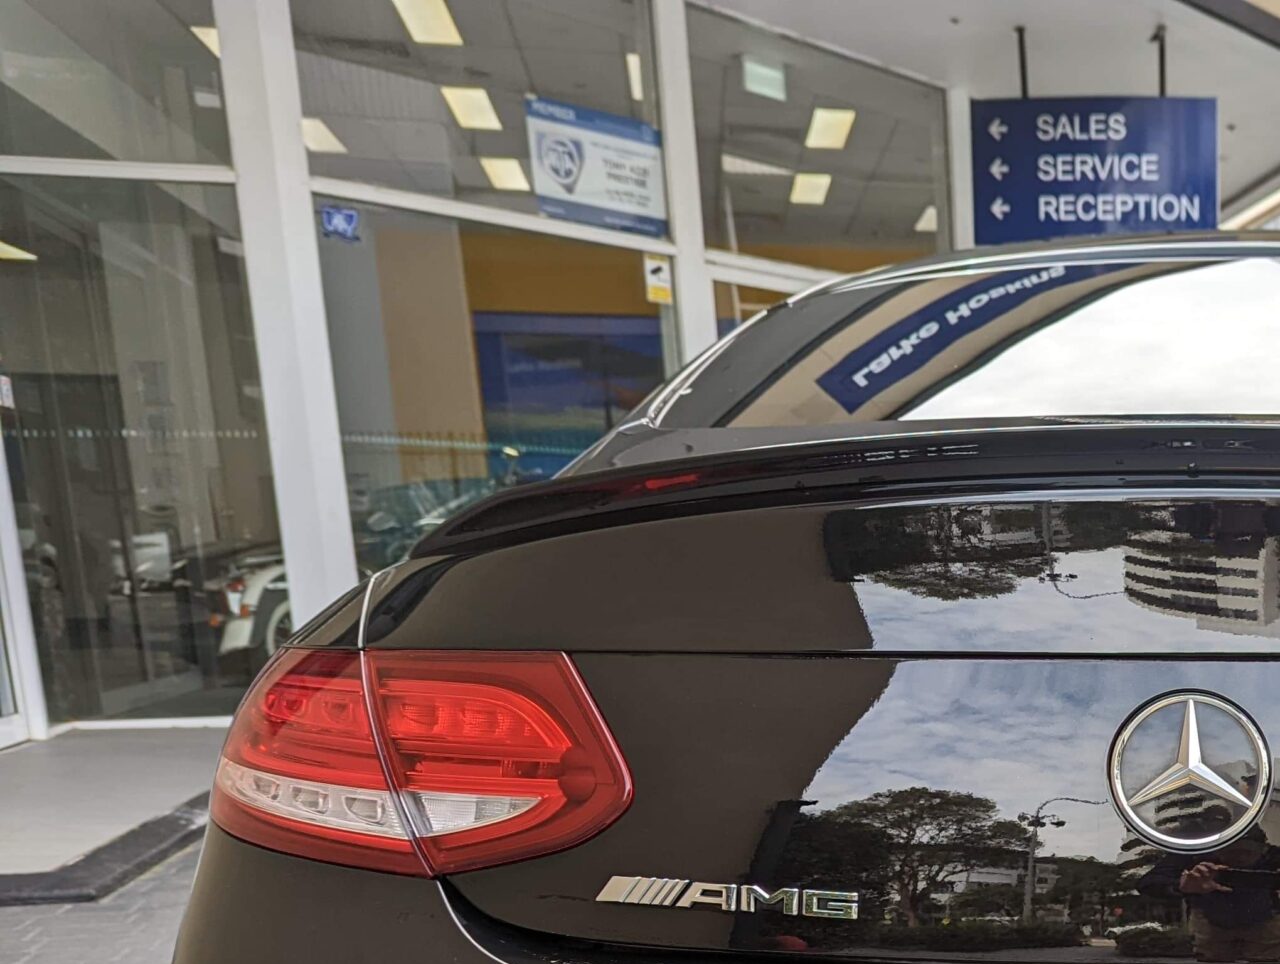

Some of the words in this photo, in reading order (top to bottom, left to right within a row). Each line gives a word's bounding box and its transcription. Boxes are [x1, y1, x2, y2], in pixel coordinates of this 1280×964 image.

[1036, 113, 1128, 141] SALES
[1037, 153, 1160, 182] SERVICE
[1038, 194, 1200, 222] RECEPTION
[675, 881, 859, 919] AMG
